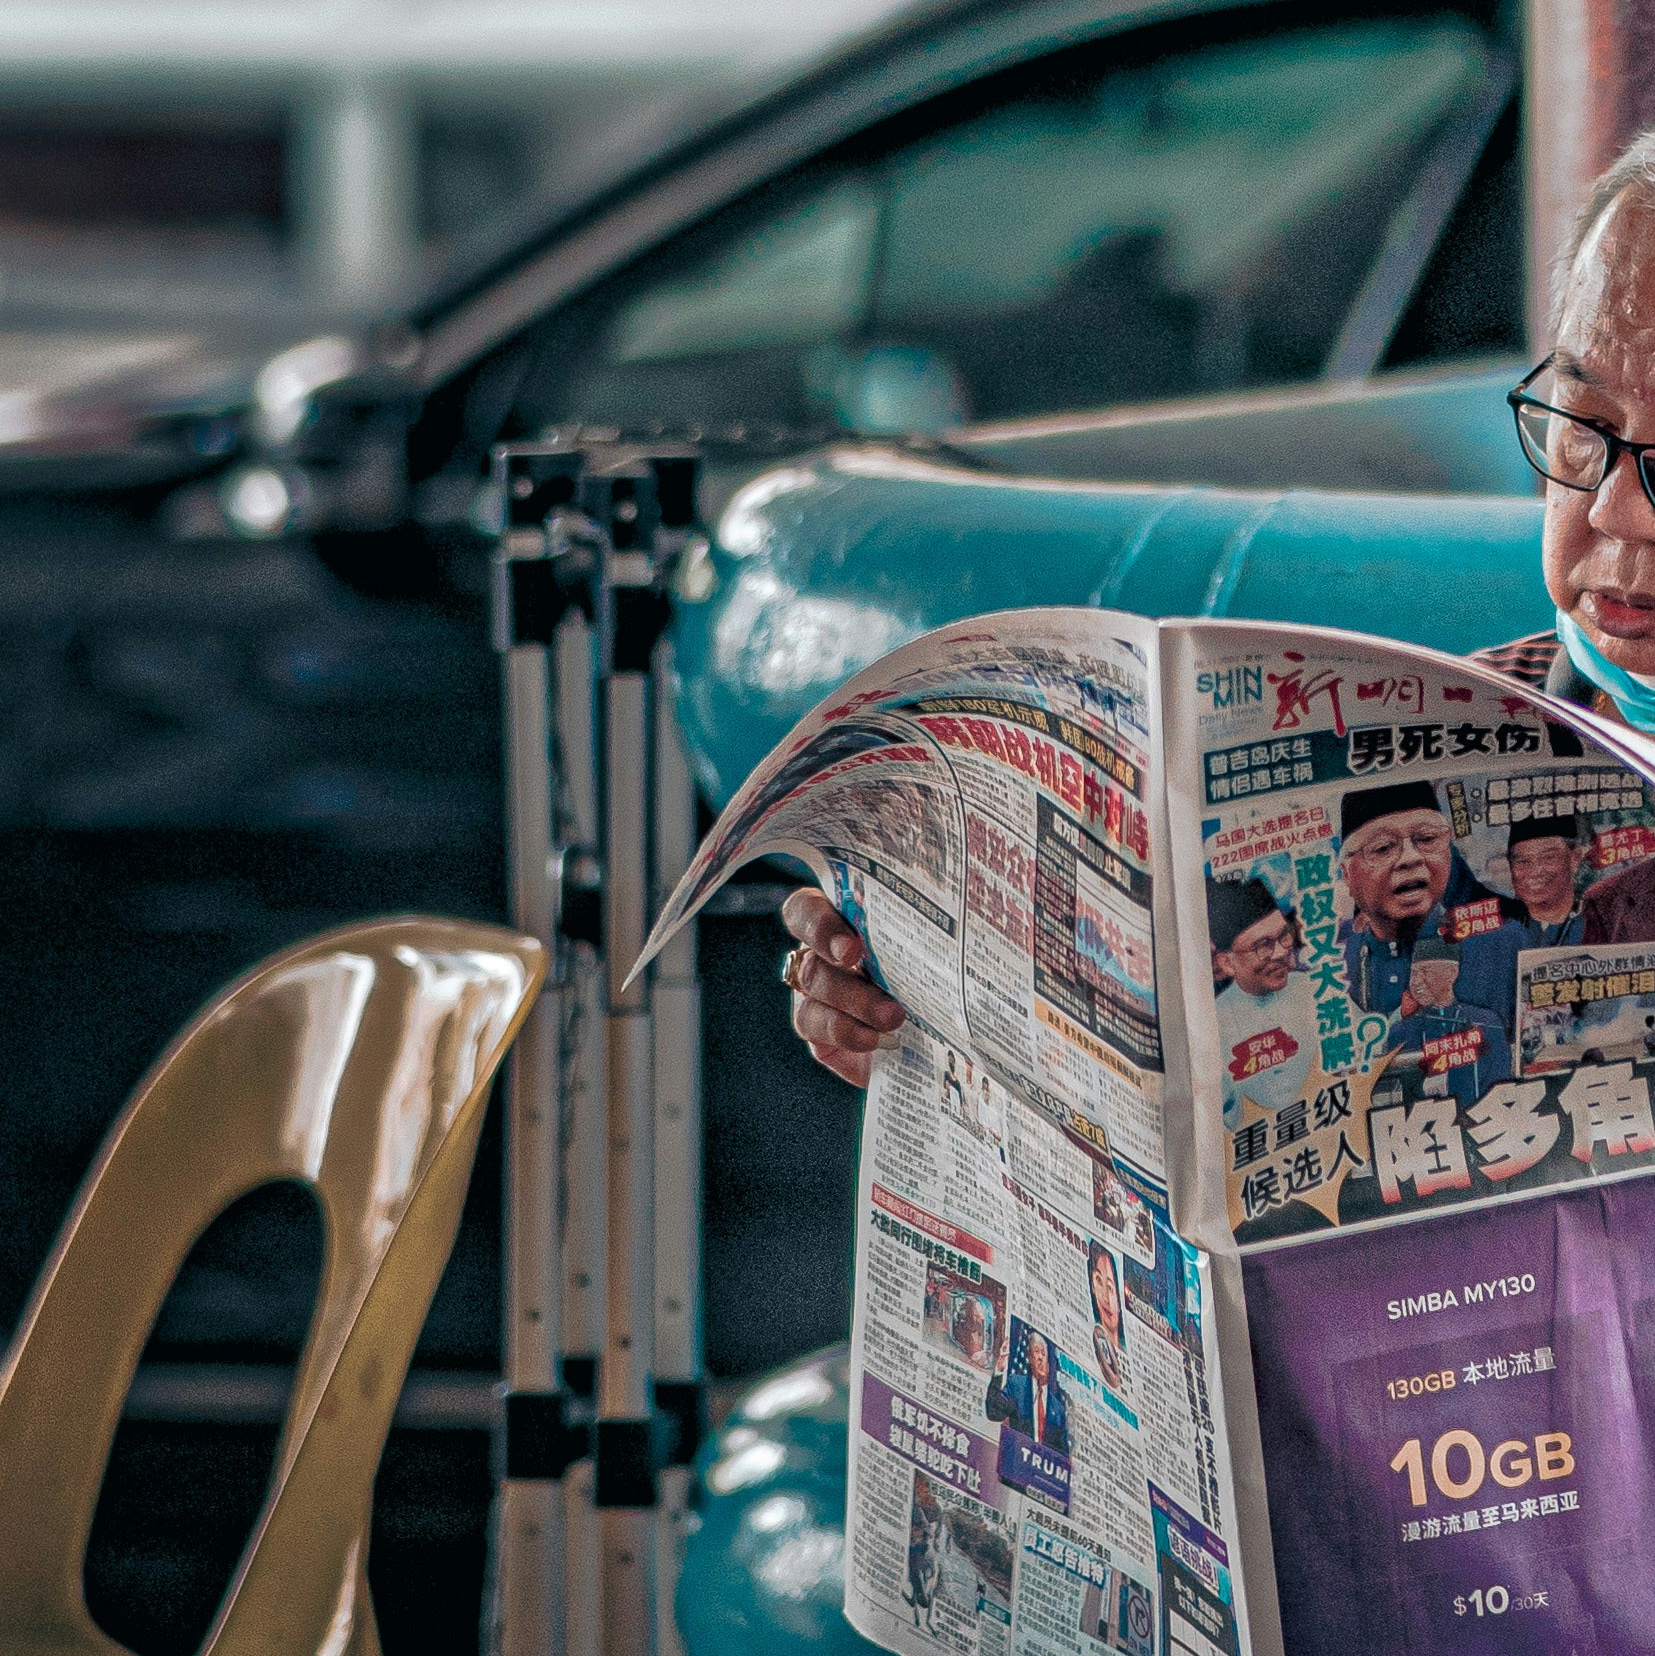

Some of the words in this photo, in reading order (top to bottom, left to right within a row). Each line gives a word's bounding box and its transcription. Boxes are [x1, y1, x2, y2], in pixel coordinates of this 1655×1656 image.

[1196, 665, 1262, 693] SHIN
[1213, 682, 1262, 710] MIN
[1210, 741, 1312, 775] 普吉岛庆生
[1351, 722, 1541, 774] 男死女伤
[1211, 762, 1314, 801] 情侣遇车祸
[1212, 823, 1333, 868] 222国席战火点燃
[1216, 806, 1325, 848] 马国大选提名日
[1601, 844, 1645, 865] 3角战
[1454, 898, 1499, 920] 依斯迈
[1455, 915, 1500, 938] 3角战
[1243, 1049, 1285, 1074] 4角战
[1424, 1028, 1482, 1057] 阿末扎希
[1433, 1047, 1477, 1072] 4角战
[1232, 1081, 1353, 1172] 重量级
[1240, 1131, 1369, 1220] 候选人
[1387, 1289, 1459, 1320] SIMBA
[1463, 1273, 1537, 1305] MY130
[1387, 1370, 1457, 1400] 130GB
[1463, 1346, 1557, 1386] 本地流量
[1390, 1429, 1576, 1507] 10GB
[1401, 1490, 1581, 1542] 漫游流量至马来西亚
